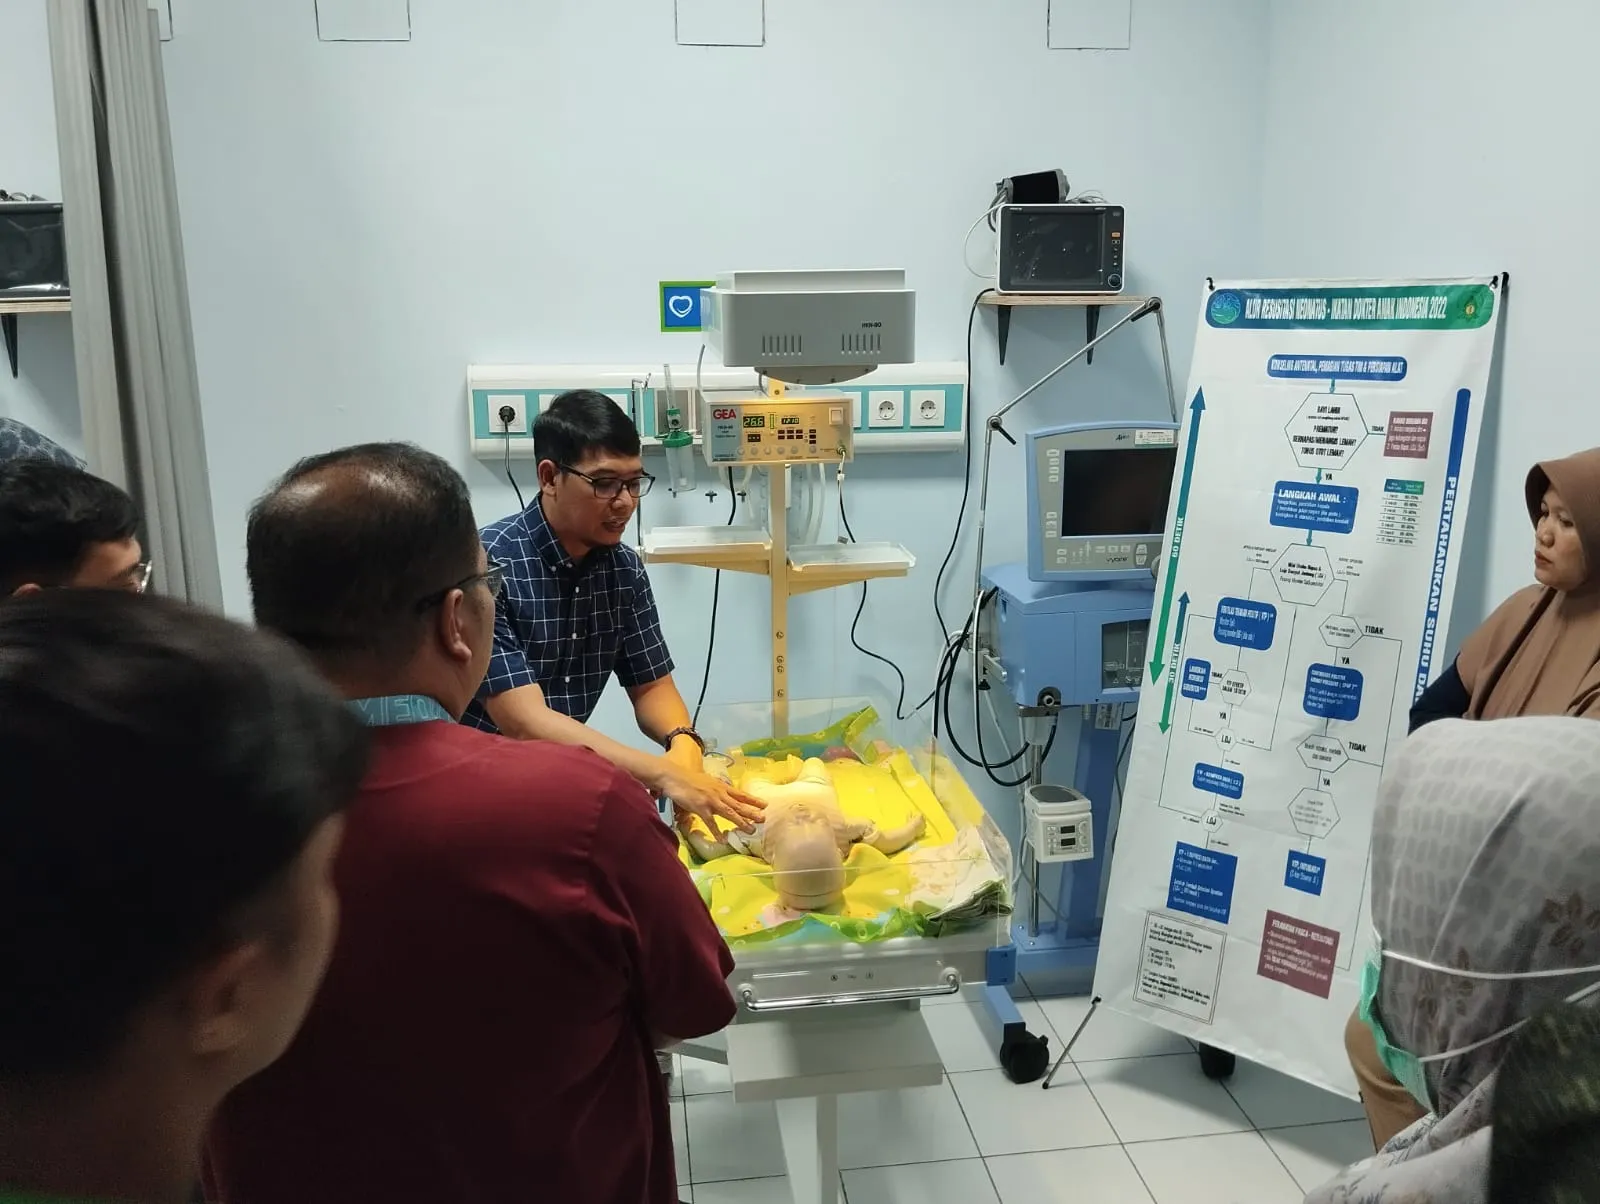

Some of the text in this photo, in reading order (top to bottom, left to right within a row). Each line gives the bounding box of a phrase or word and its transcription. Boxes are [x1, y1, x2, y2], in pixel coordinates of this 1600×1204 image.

[1353, 297, 1376, 320] DOKTER
[1428, 296, 1448, 319] 2022
[712, 408, 737, 420] GEA
[1325, 473, 1333, 481] YA
[1278, 488, 1318, 502] LANGKAH
[1317, 491, 1341, 504] AWAL
[1172, 516, 1184, 545] DETIK
[1414, 476, 1458, 703] PERTAHANKAN SUHU DA
[1365, 625, 1385, 635] TIDAK
[1170, 642, 1181, 669] DETIK
[1341, 656, 1350, 665] YA
[1218, 711, 1228, 721] YA
[1348, 741, 1367, 753] TIDAK
[1322, 777, 1331, 787] YA
